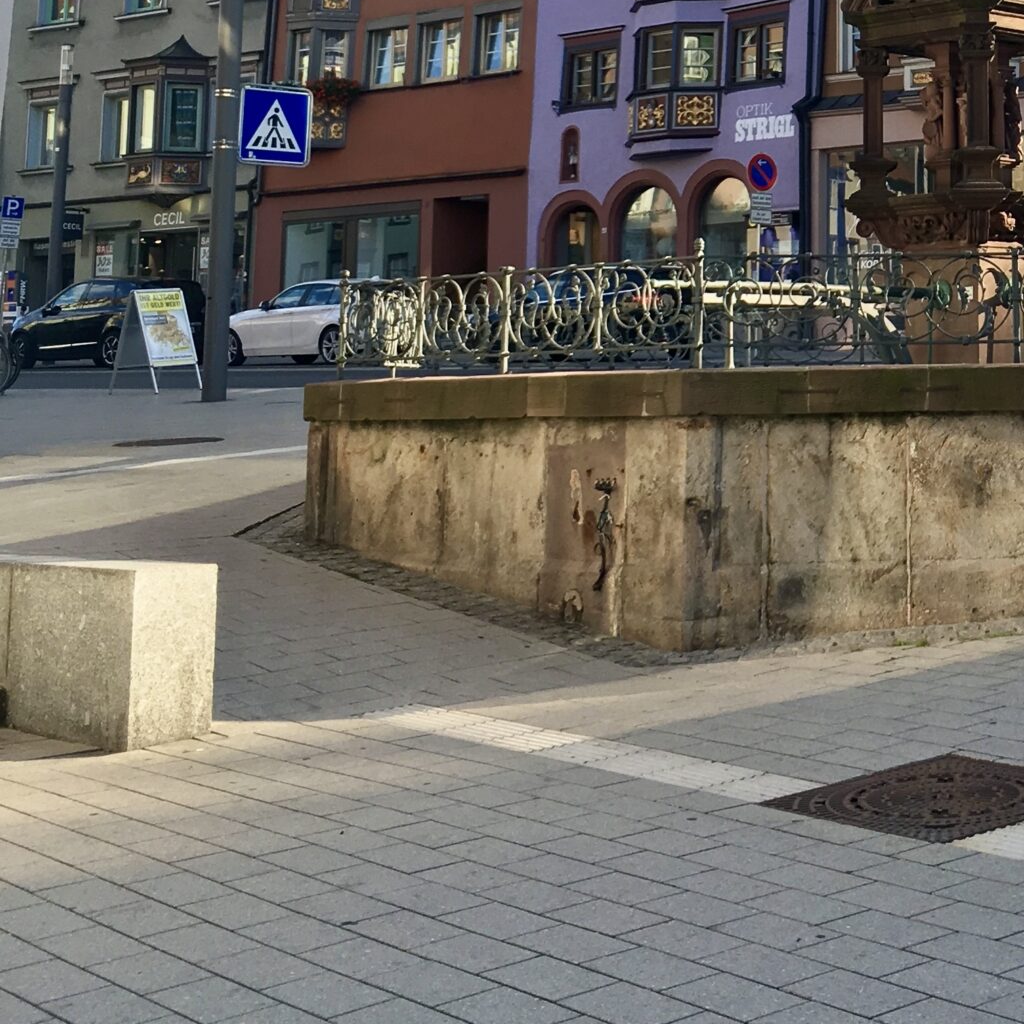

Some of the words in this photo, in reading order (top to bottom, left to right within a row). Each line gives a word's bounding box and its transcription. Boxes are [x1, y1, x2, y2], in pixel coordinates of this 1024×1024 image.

[736, 102, 773, 118] OPTIK
[734, 113, 795, 143] STRIGL
[6, 199, 19, 216] P
[62, 222, 81, 230] CECIL
[153, 211, 185, 226] CECIL
